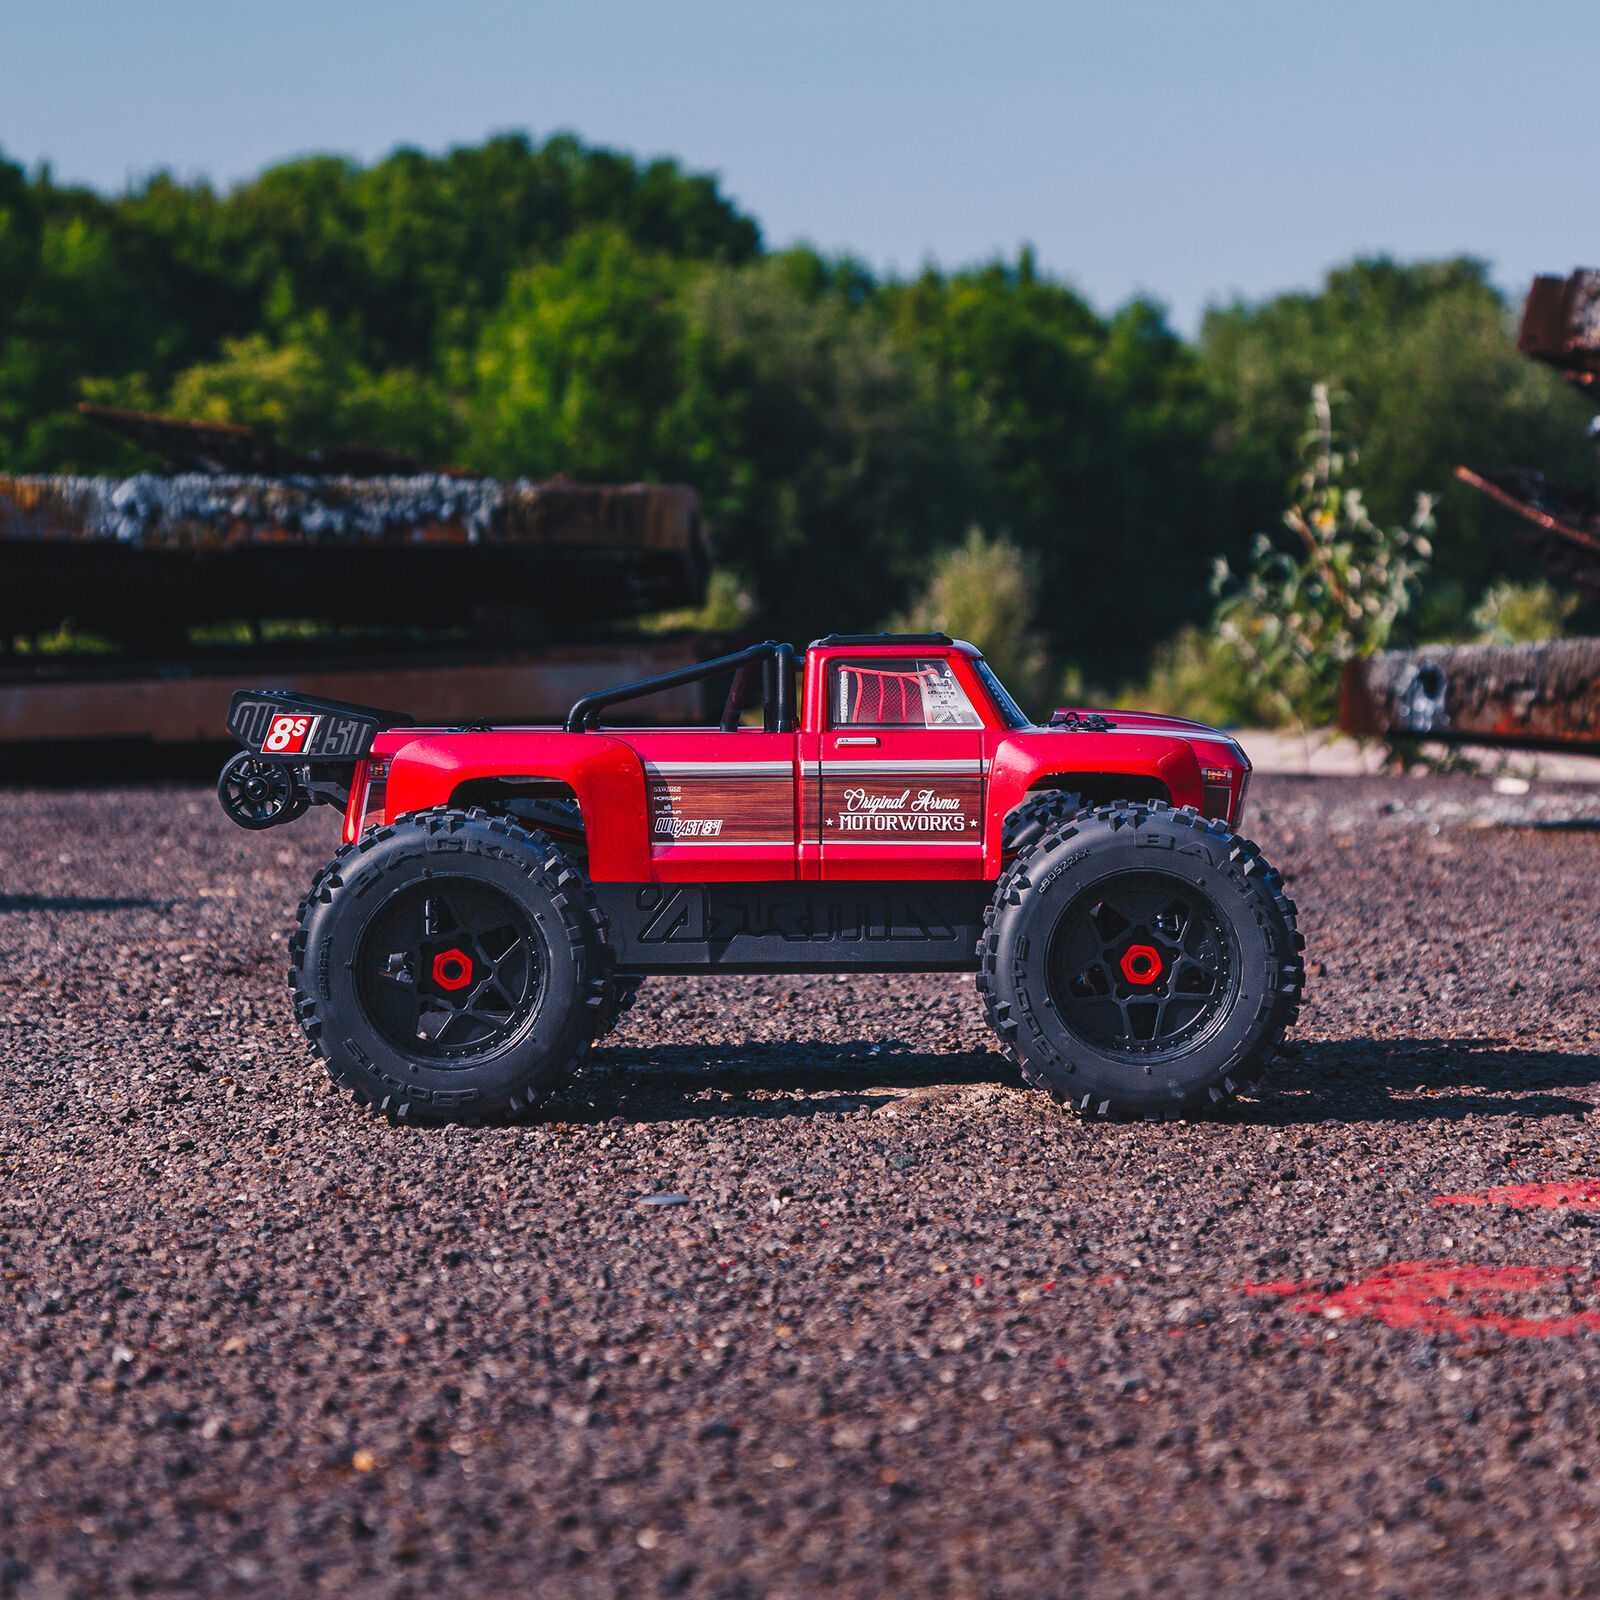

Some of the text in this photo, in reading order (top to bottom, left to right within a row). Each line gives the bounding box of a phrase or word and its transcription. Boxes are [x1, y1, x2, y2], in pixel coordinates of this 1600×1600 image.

[843, 788, 960, 813] Original Arrma
[654, 817, 702, 838] OUTCAST
[838, 815, 965, 831] MOTORWORKS
